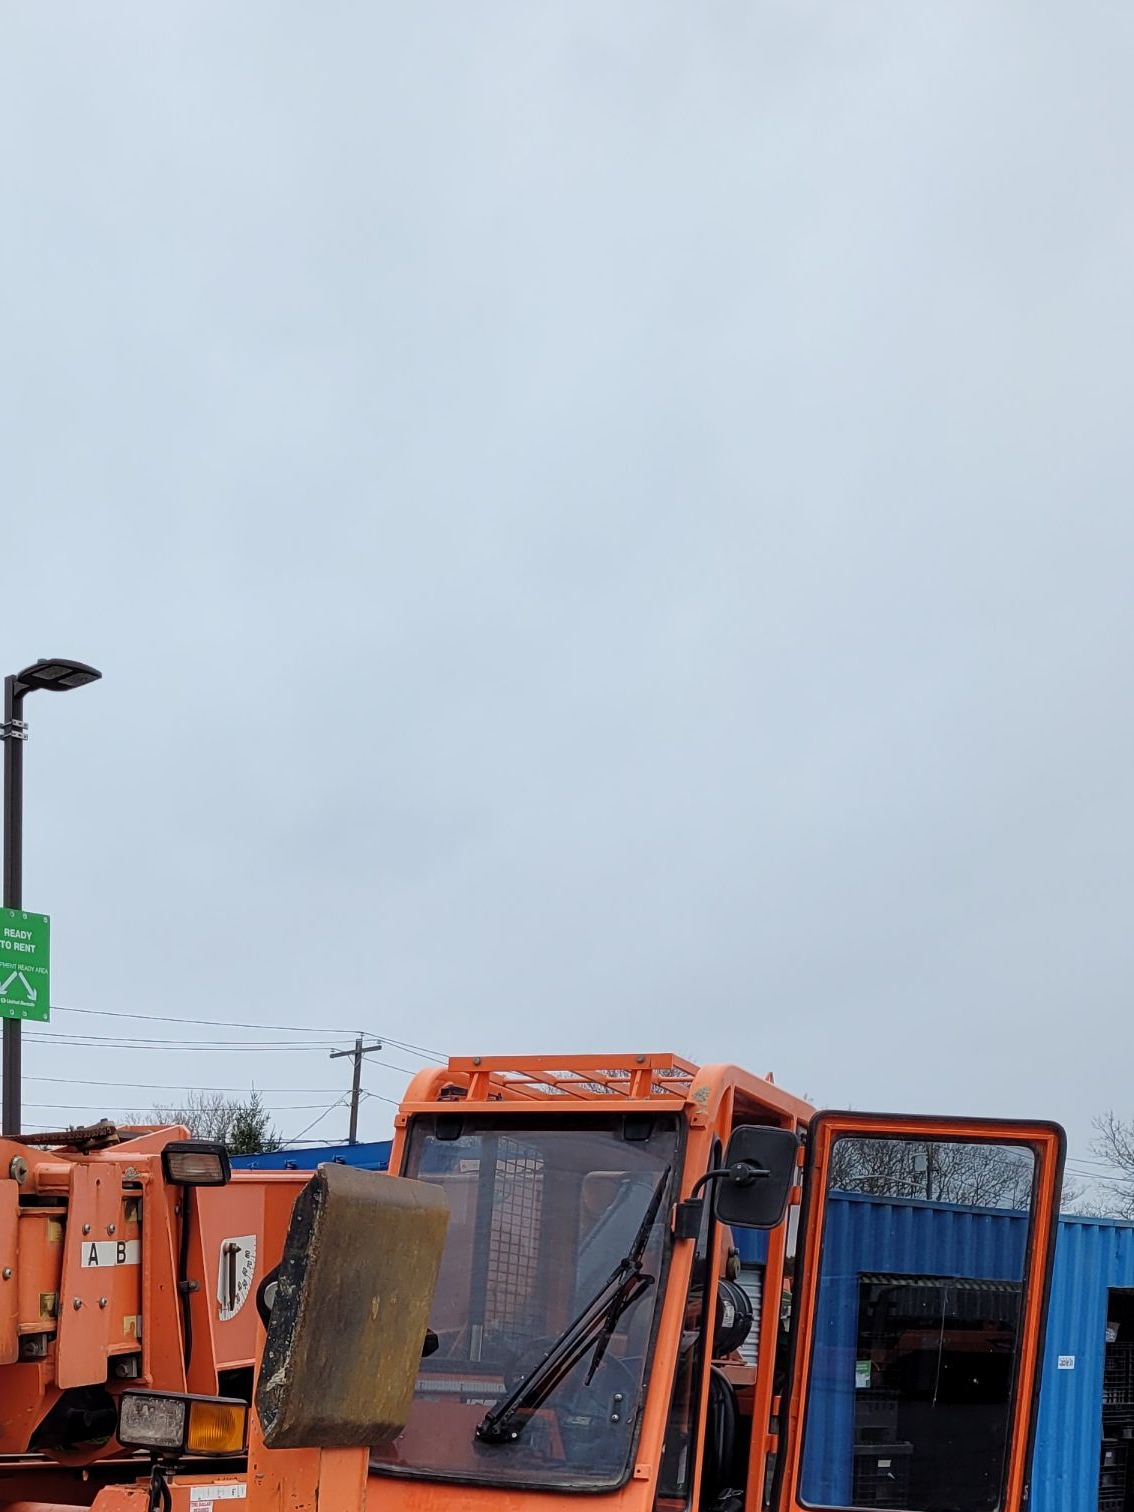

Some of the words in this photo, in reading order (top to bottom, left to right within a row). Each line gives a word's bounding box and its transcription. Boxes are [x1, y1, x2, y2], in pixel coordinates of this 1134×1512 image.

[3, 928, 33, 940] READY
[0, 940, 12, 950] TO
[13, 942, 36, 953] RENT
[17, 964, 34, 972] READY
[88, 1242, 99, 1266] A
[116, 1241, 126, 1264] B
